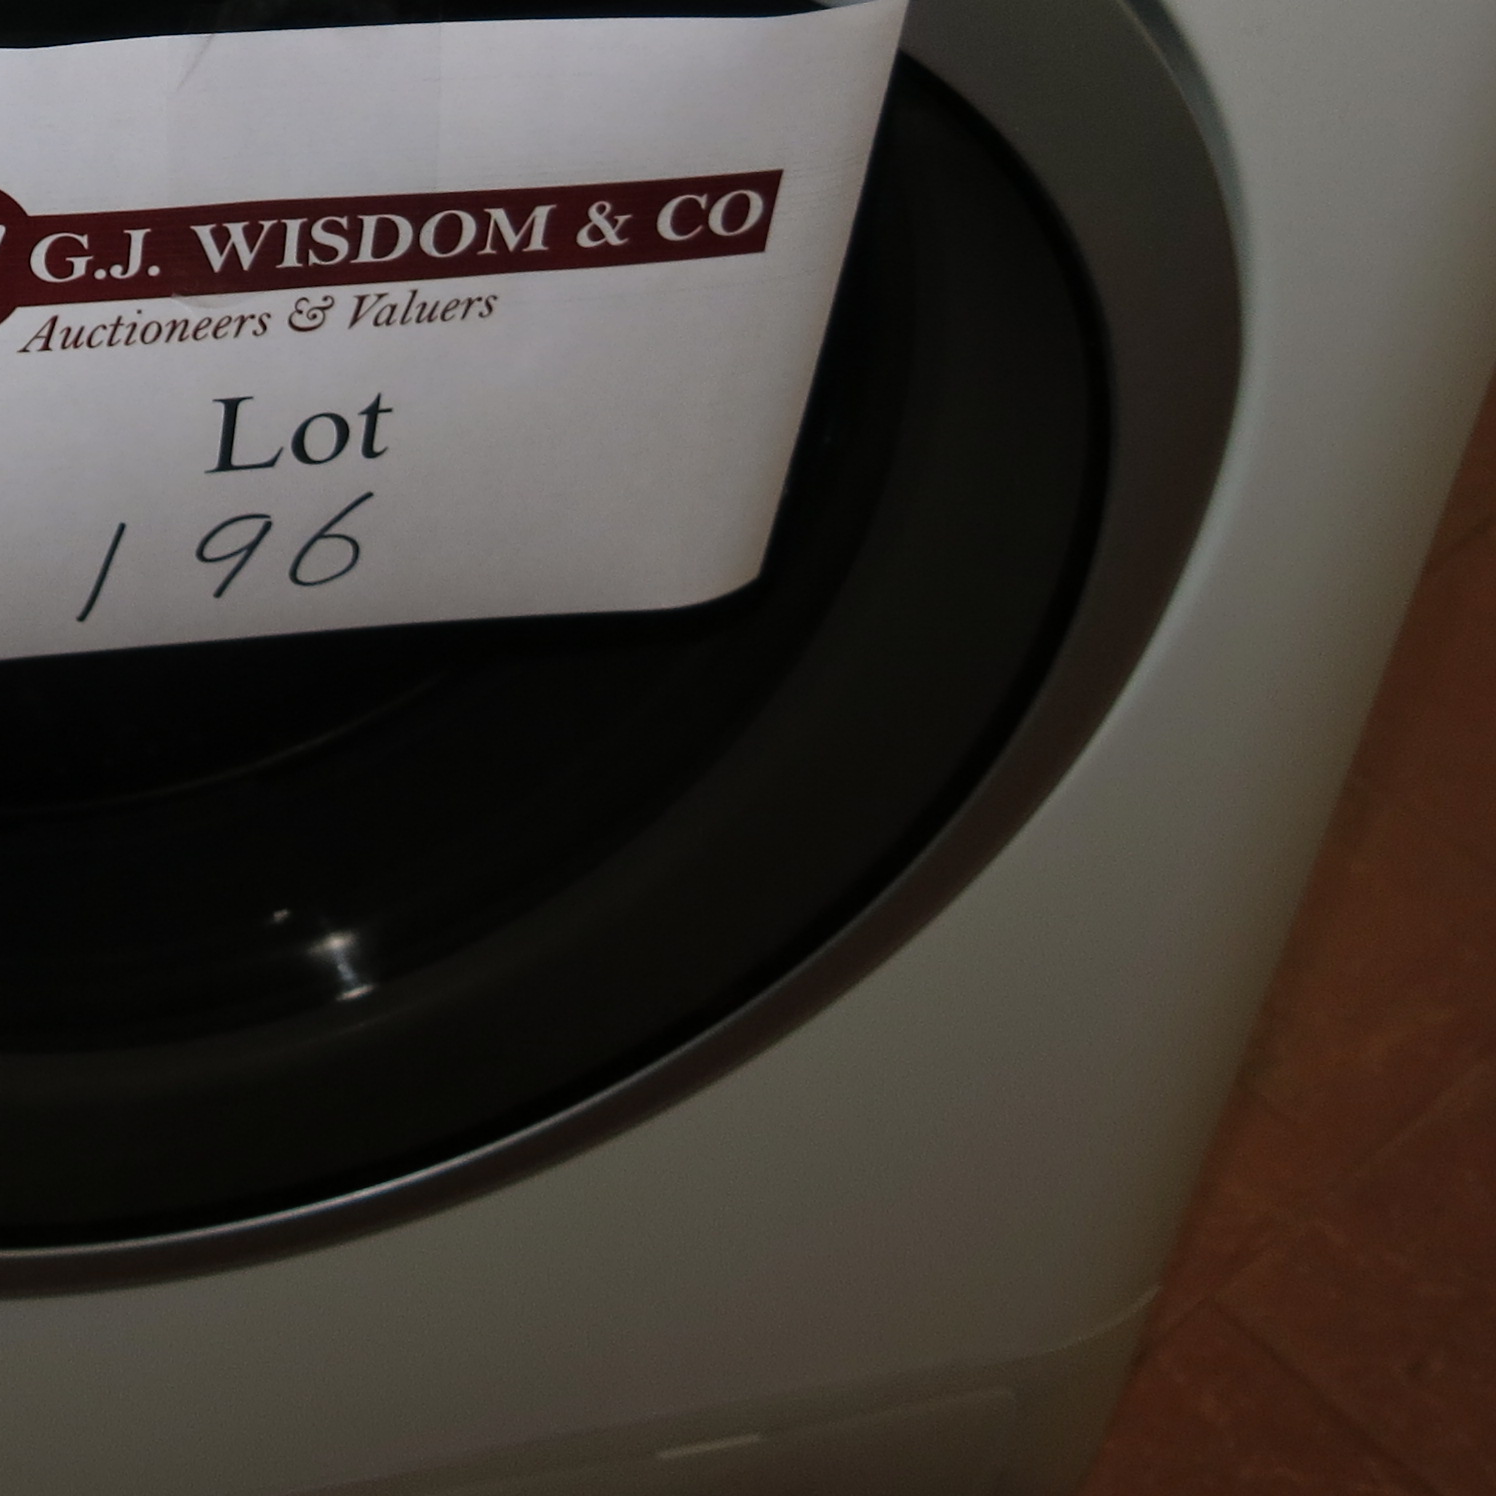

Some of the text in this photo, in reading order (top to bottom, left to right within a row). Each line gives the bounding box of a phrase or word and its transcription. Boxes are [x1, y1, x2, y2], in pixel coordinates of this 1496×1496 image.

[29, 186, 765, 283] G.J. WISDOM & CO
[17, 286, 499, 355] Auctioneers & Valuers
[204, 392, 393, 473] Lot
